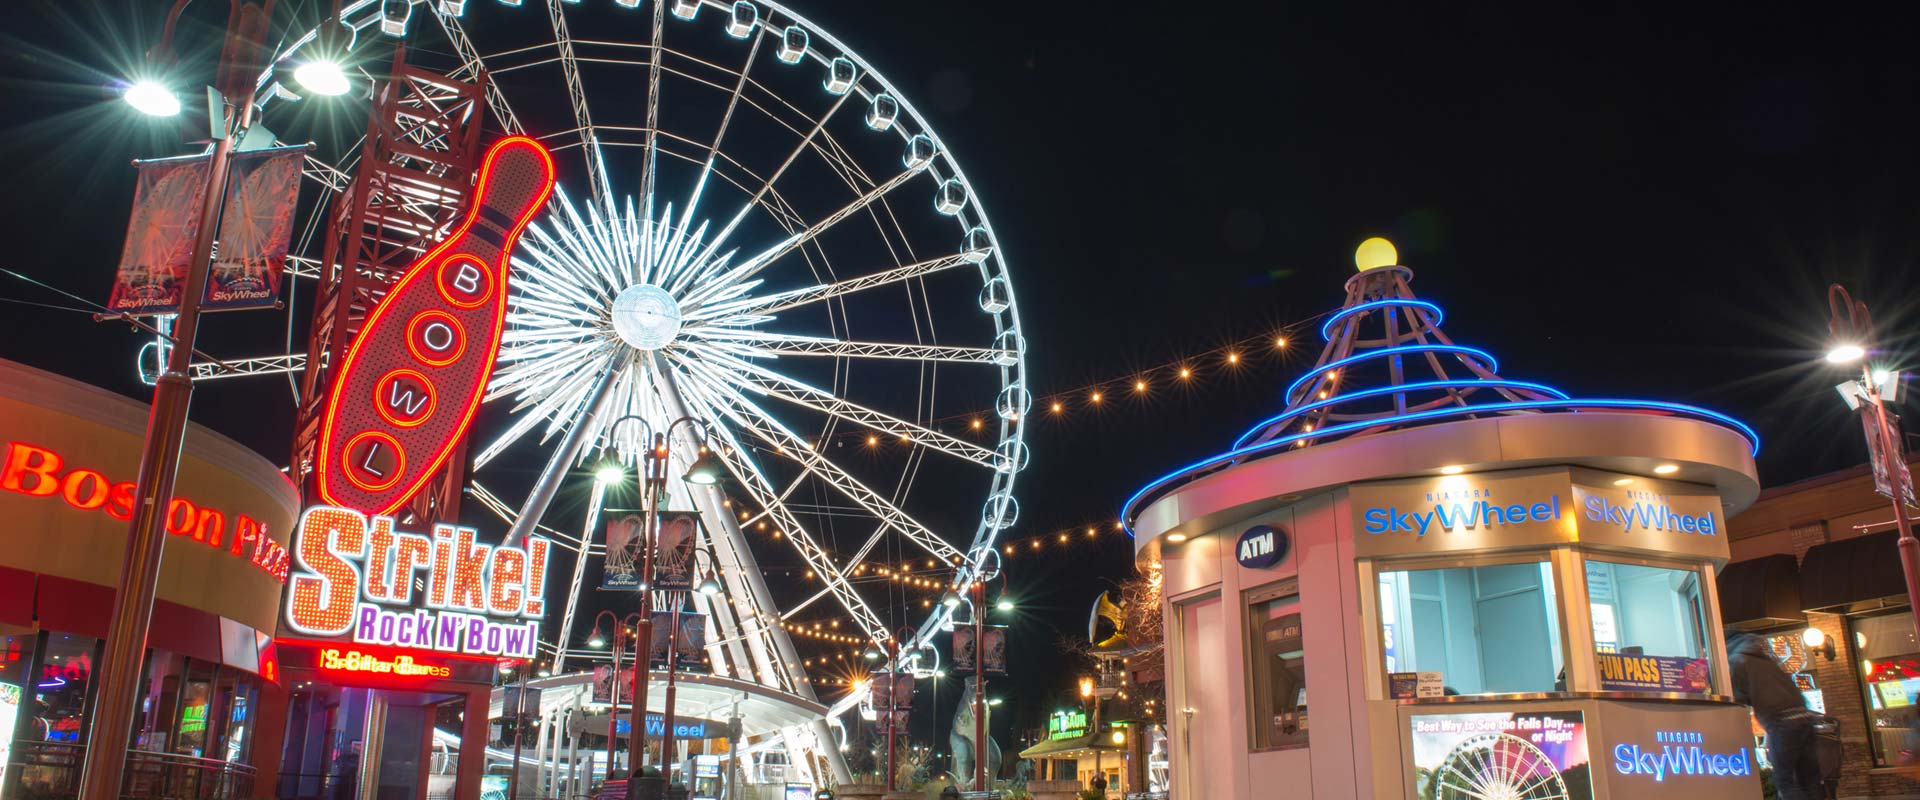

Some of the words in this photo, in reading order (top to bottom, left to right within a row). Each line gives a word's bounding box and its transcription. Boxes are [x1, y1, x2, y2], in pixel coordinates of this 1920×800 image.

[117, 297, 173, 309] SkyWheel
[213, 289, 271, 301] SkyWheel
[0, 441, 225, 548] Boson
[1364, 495, 1561, 537] SkyWheel
[1584, 495, 1717, 537] SkyWheel
[1240, 531, 1275, 561] ATM
[286, 504, 551, 637] Strike!
[607, 579, 638, 587] SkyWheel
[354, 603, 435, 650] Rock
[464, 614, 539, 659] Bowl
[1283, 626, 1299, 638] ATM
[1623, 657, 1660, 683] PASS
[616, 719, 705, 737] SkWeel
[1416, 720, 1439, 733] Best
[1441, 719, 1463, 734] Way
[1464, 720, 1475, 731] to
[1477, 719, 1497, 731] See
[1498, 718, 1516, 731] the
[1517, 717, 1541, 730] Falls
[1531, 731, 1543, 743] or
[1544, 730, 1574, 745] Night
[1656, 731, 1704, 744] NIAGARA
[1614, 743, 1751, 781] SkyWheel
